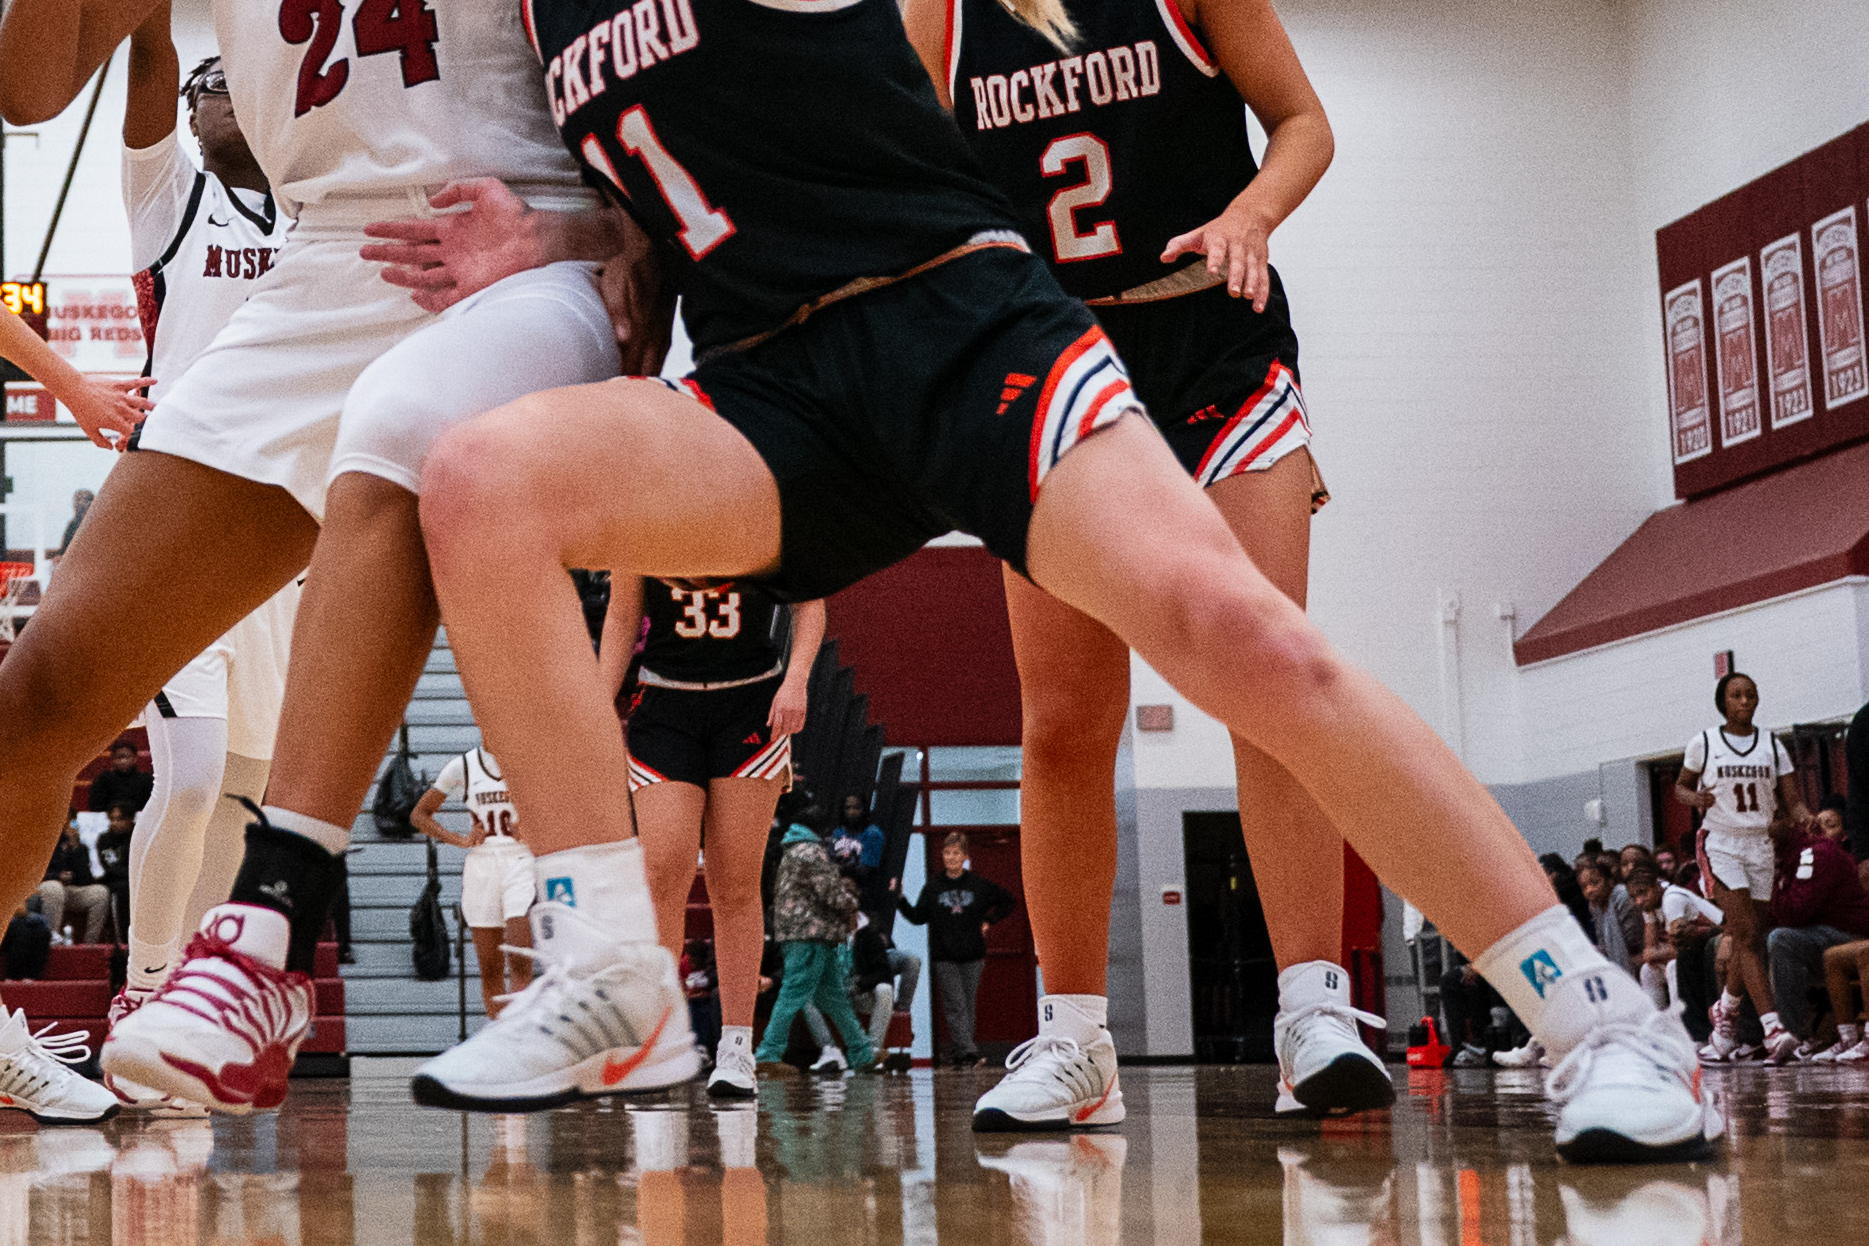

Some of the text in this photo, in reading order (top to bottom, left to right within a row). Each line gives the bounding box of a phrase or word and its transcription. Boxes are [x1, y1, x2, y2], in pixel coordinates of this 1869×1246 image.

[971, 40, 1161, 130] ROCKFORD
[1039, 131, 1123, 264] 2
[203, 244, 280, 280] MUSK
[91, 327, 142, 341] REDS
[671, 587, 741, 638] 33
[1733, 782, 1759, 812] 11
